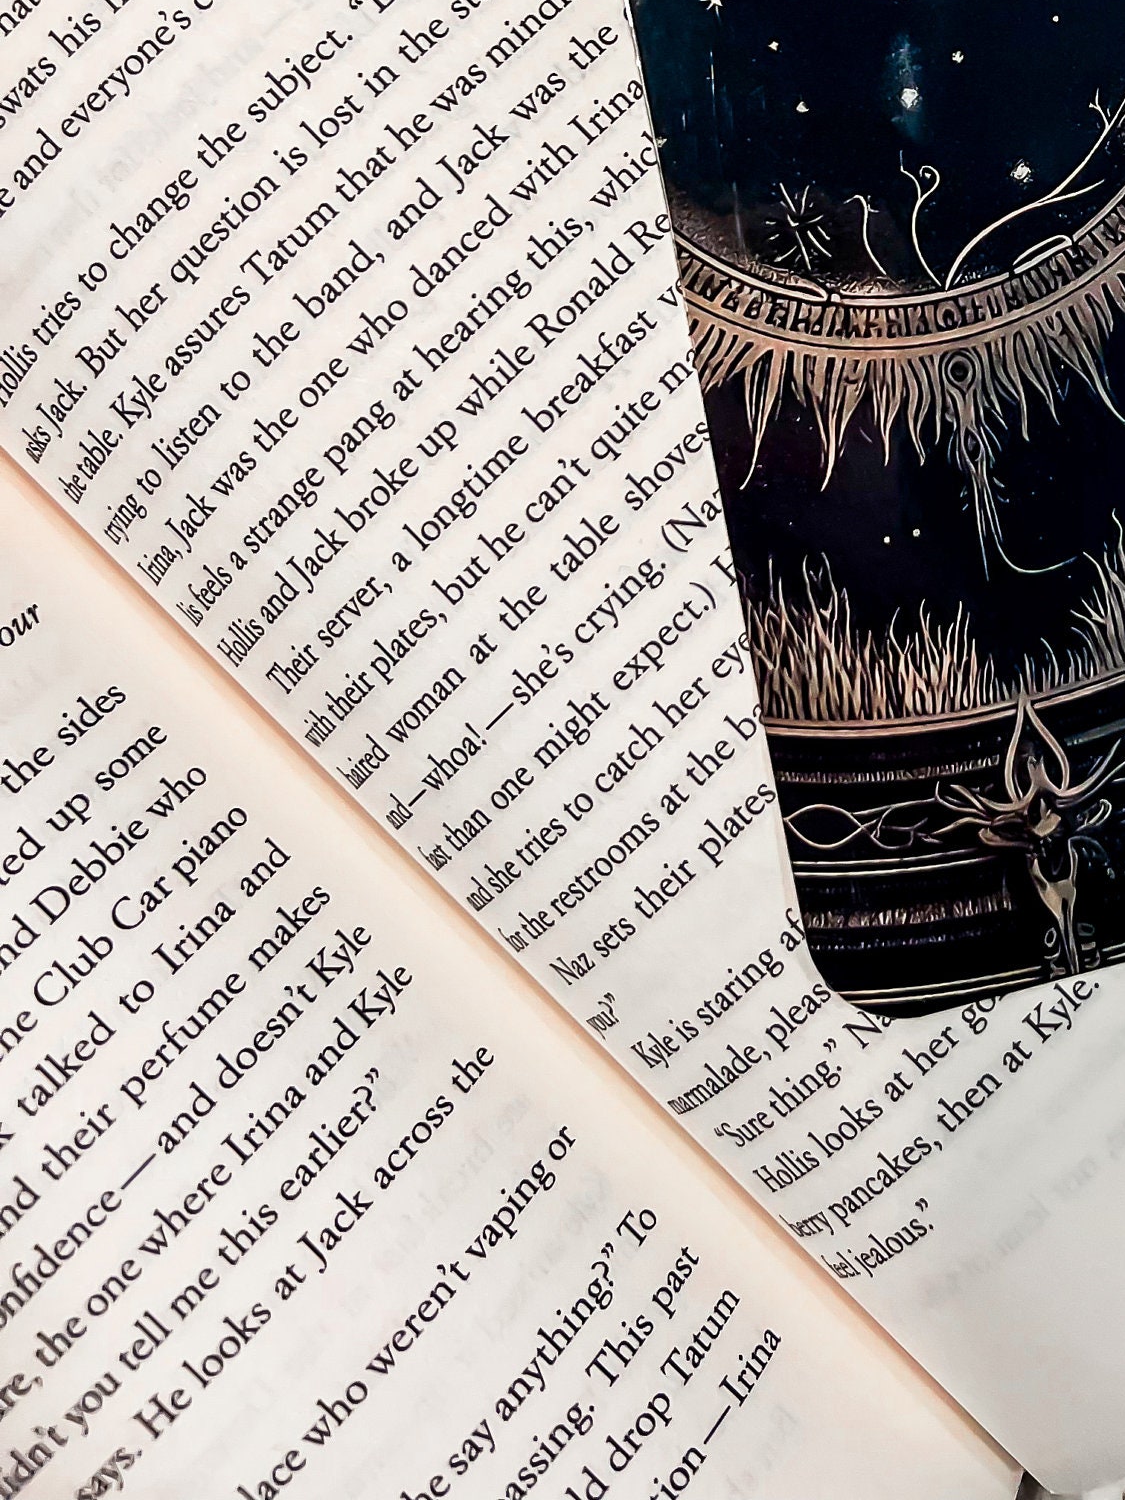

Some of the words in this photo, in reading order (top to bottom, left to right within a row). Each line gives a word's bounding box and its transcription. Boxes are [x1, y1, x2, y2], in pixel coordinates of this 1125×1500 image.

[31, 291, 82, 346] tries
[109, 169, 199, 260] change
[247, 29, 354, 124] subject.
[108, 373, 168, 430] Kyle
[165, 285, 251, 377] assures
[239, 202, 341, 286] Tatum
[335, 145, 397, 203] that
[150, 404, 223, 471] listen
[252, 321, 301, 368] the
[291, 239, 385, 320] band,
[435, 123, 511, 195] Jack
[170, 175, 281, 285] question
[272, 146, 308, 176] is
[299, 94, 365, 149] lost
[164, 493, 218, 554] Jack
[345, 300, 409, 355] who
[408, 193, 514, 298] danced
[508, 141, 579, 201] with
[243, 467, 325, 554] strange
[322, 399, 396, 476] pang
[411, 269, 533, 373] hearing
[526, 217, 595, 271] this,
[285, 527, 350, 594] Jack
[333, 457, 420, 534] broke
[416, 420, 459, 458] up
[455, 345, 536, 417] while
[523, 241, 636, 349] Ronald
[265, 643, 320, 695] Their
[317, 576, 393, 648] server,
[401, 435, 529, 552] longtime
[520, 310, 658, 434] breakfast
[369, 608, 448, 686] plates,
[431, 555, 491, 606] but
[590, 391, 661, 462] quite
[574, 558, 667, 644] crying.
[57, 685, 127, 747] sides
[335, 733, 391, 790] haired
[385, 667, 467, 744] woman
[549, 514, 621, 582] table
[442, 809, 493, 852] than
[532, 691, 611, 770] might
[612, 581, 717, 691] expect.)
[595, 723, 666, 793] catch
[28, 820, 150, 926] Debbie
[145, 767, 207, 818] who
[45, 793, 92, 832] up
[94, 726, 168, 792] some
[550, 812, 661, 918] restrooms
[686, 740, 736, 787] the
[17, 1010, 117, 1117] talked
[151, 901, 237, 976] Irina
[240, 837, 292, 898] and
[33, 935, 114, 1007] Club
[111, 875, 173, 930] Car
[171, 807, 248, 888] piano
[592, 917, 636, 958] sets
[633, 859, 697, 920] their
[630, 1032, 681, 1069] Kyle
[696, 948, 785, 1026] staring
[41, 1103, 117, 1181] their
[119, 973, 247, 1110] perfume
[247, 886, 331, 972] makes
[87, 1259, 143, 1317] one
[138, 1164, 233, 1256] where
[220, 1085, 307, 1166] Irina
[346, 966, 413, 1029] Kyle
[752, 1149, 821, 1193] Hollis
[807, 1099, 884, 1159] looks
[901, 1026, 960, 1077] her
[827, 1136, 943, 1228] pancakes,
[936, 1073, 1003, 1133] then
[1021, 980, 1100, 1045] Kyle.
[118, 1310, 173, 1371] tell
[218, 1204, 279, 1266] this
[132, 1389, 192, 1440] He
[181, 1302, 272, 1389] looks
[274, 1263, 307, 1301] at
[296, 1190, 374, 1274] Jack
[373, 1095, 455, 1190] across
[464, 1159, 556, 1259] vaping
[584, 1314, 654, 1388] This
[651, 1246, 700, 1320] past
[448, 1418, 496, 1476] say
[615, 1208, 657, 1248] To
[605, 1392, 673, 1472] drop
[659, 1290, 741, 1387] Tatum
